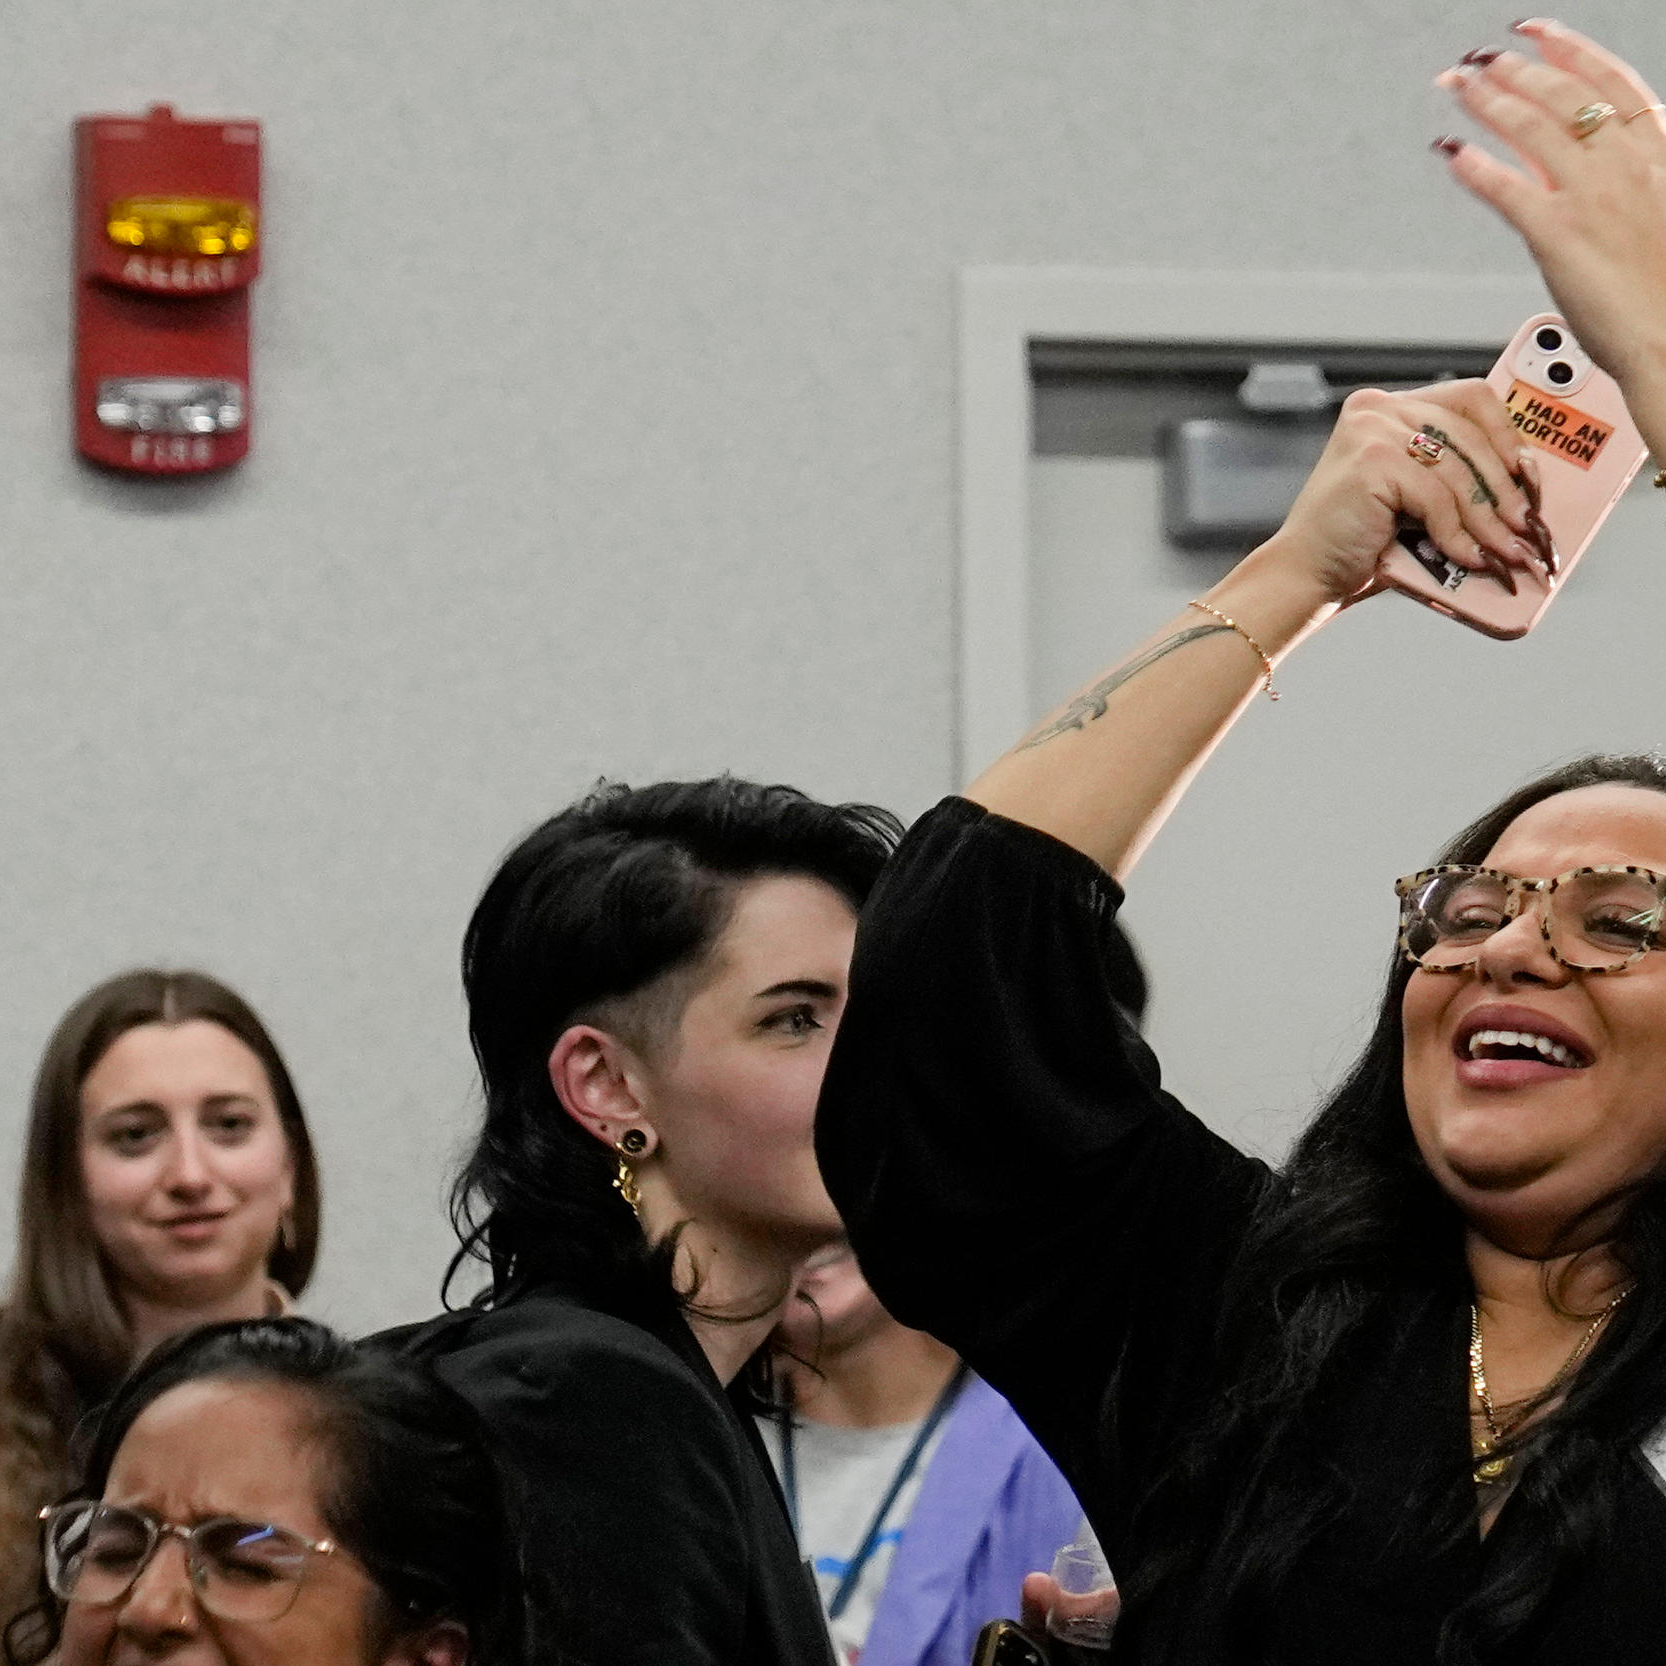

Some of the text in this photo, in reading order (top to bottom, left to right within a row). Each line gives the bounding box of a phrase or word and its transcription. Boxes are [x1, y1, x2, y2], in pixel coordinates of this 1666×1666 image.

[1505, 389, 1607, 447] I HAD AN
[1508, 408, 1597, 464] BORTION
